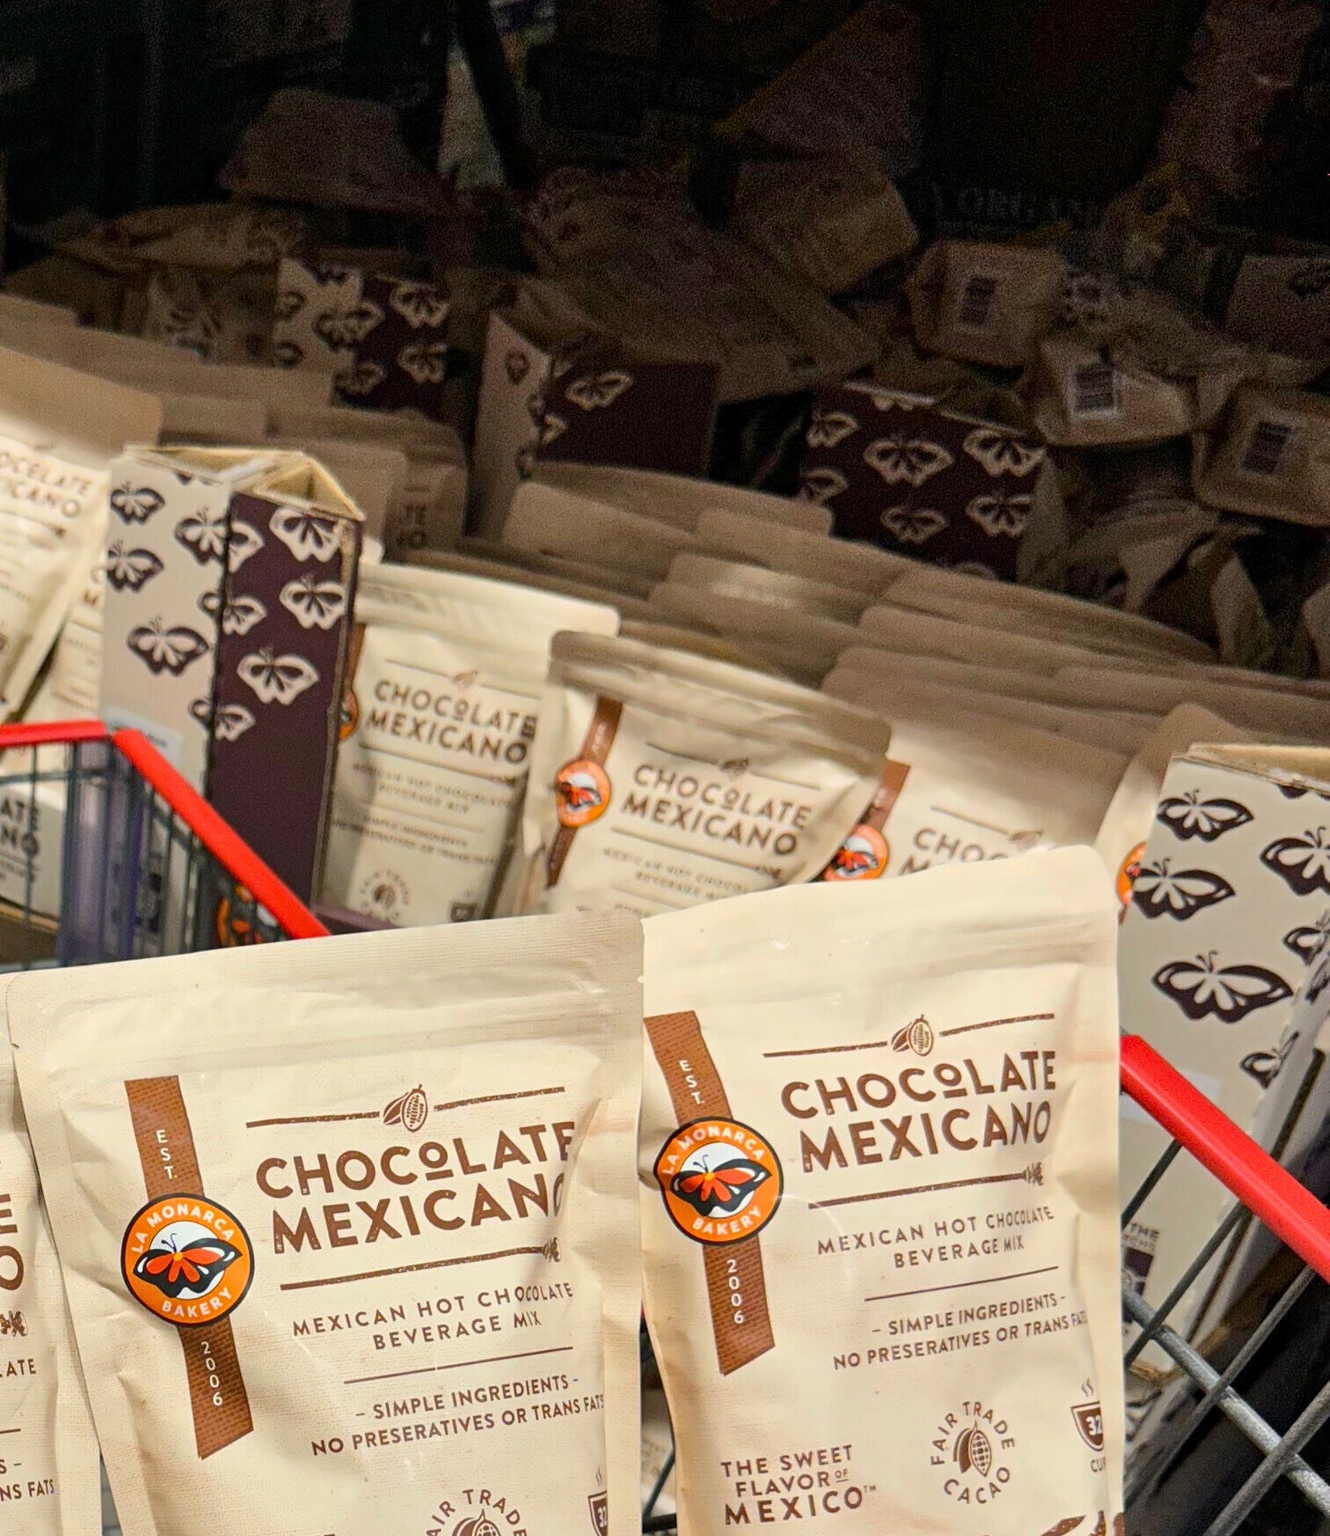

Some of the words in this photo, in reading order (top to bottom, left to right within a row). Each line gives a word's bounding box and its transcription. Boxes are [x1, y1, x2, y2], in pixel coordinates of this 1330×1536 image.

[366, 708, 529, 766] MEXICANO
[621, 791, 799, 856] MEXICANO
[157, 1128, 179, 1181] EST.
[662, 1153, 679, 1175] LA
[679, 1126, 765, 1160] MONARCA
[799, 1101, 1052, 1173] MEXICANO
[131, 1231, 147, 1252] LA
[146, 1204, 235, 1241] MONARCA
[692, 1206, 762, 1235] BAKERY
[161, 1286, 233, 1318] BAKERY
[726, 1259, 744, 1324] 2006
[201, 1341, 223, 1406] 2006
[930, 1413, 957, 1466] FAIR
[962, 1401, 1015, 1449] TRADE
[28, 1479, 55, 1498] FATS
[943, 1466, 1010, 1504] CACAO
